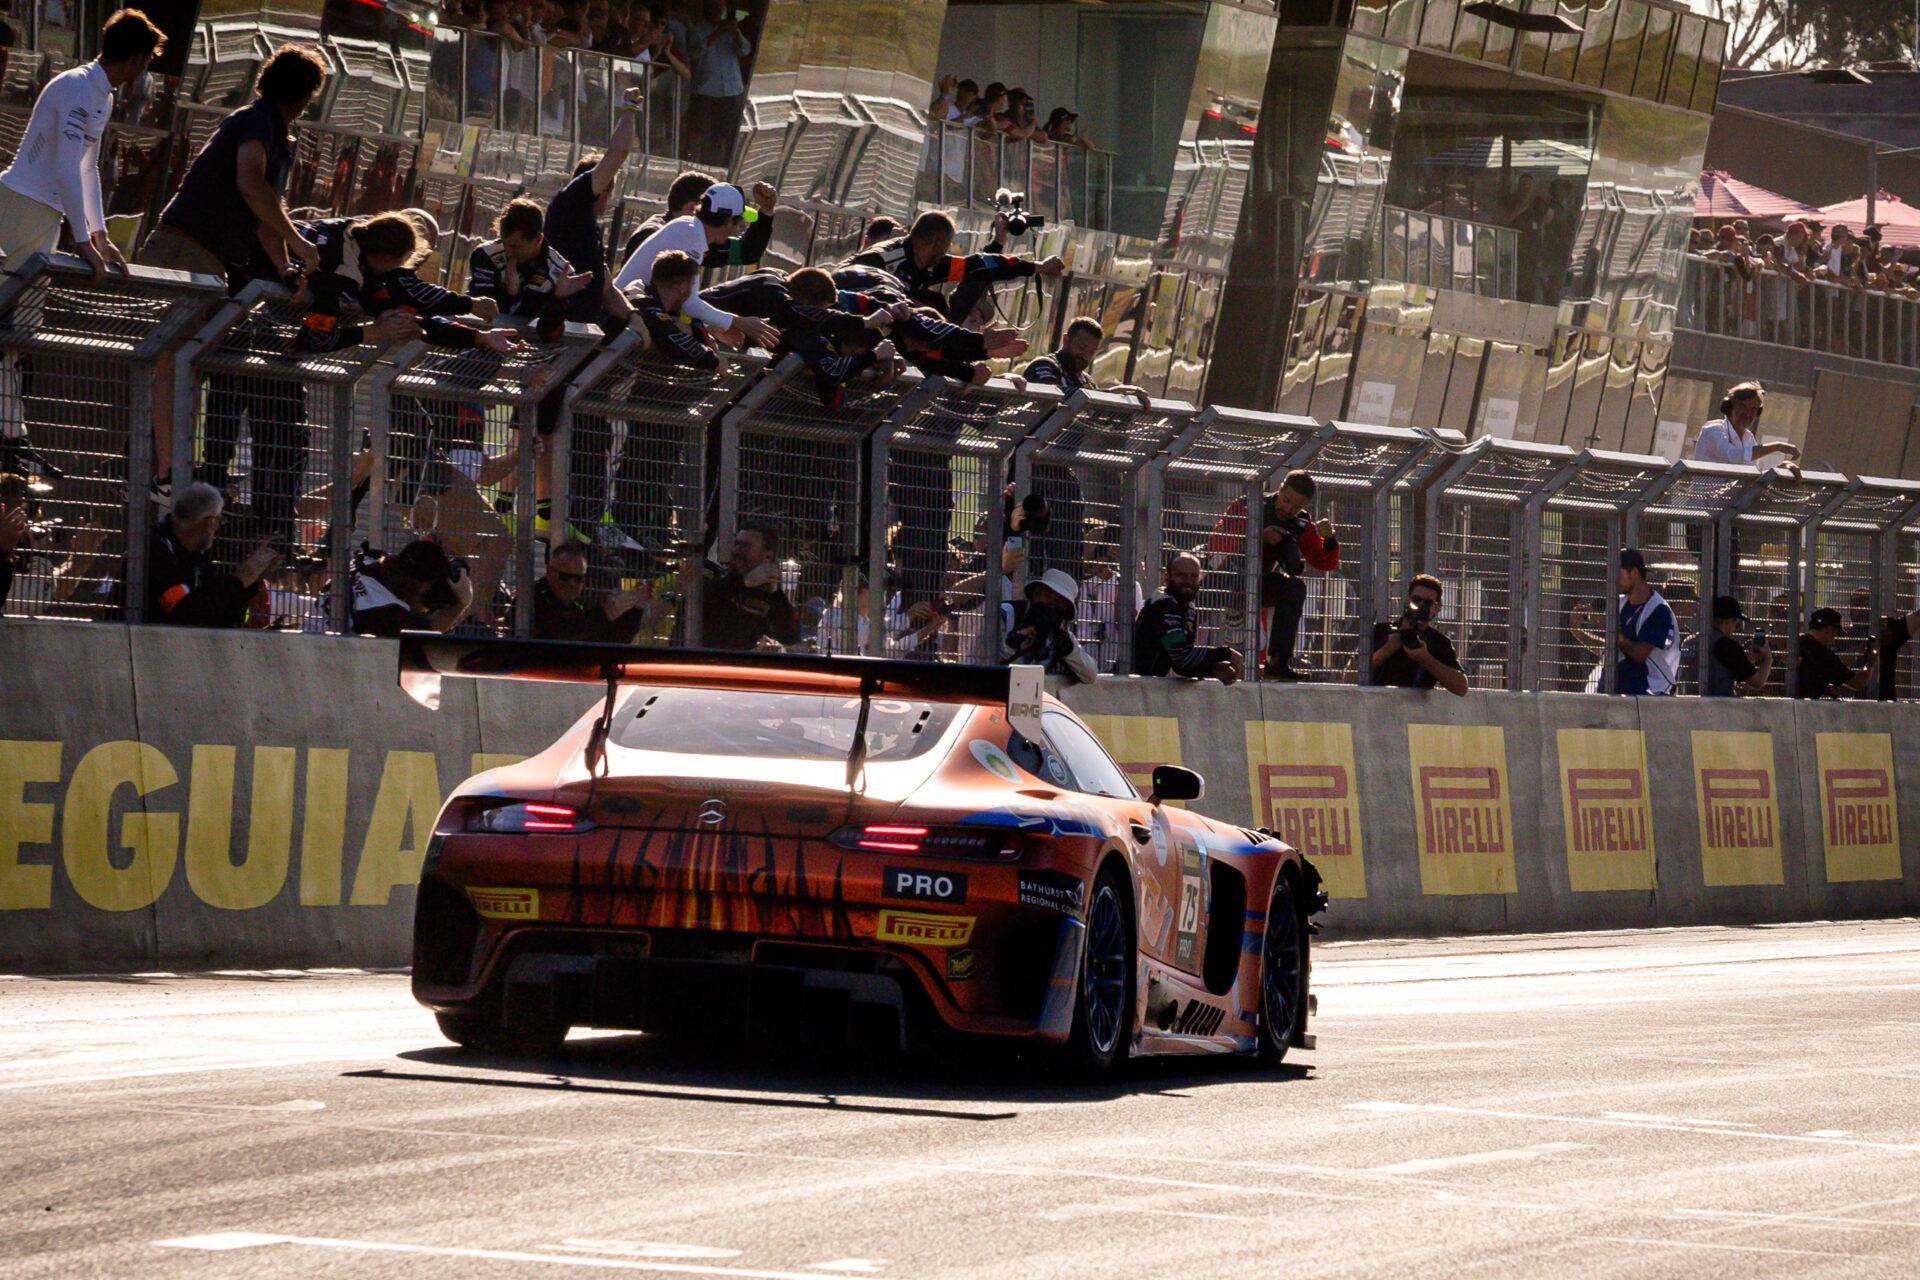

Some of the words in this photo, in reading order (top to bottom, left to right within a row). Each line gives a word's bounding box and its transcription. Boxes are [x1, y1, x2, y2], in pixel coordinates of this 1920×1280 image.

[1258, 764, 1353, 856] PIRELLI
[1420, 765, 1505, 854] PIRELLI
[1568, 767, 1647, 852] PIRELLI
[1701, 768, 1774, 849] PIRELLI
[1825, 768, 1893, 846] PIRELLI
[896, 873, 954, 898] PRO
[1020, 880, 1064, 900] BATHURST
[1020, 893, 1060, 912] REGIONAL
[1182, 884, 1199, 931] 75
[885, 914, 970, 940] PIRELLI
